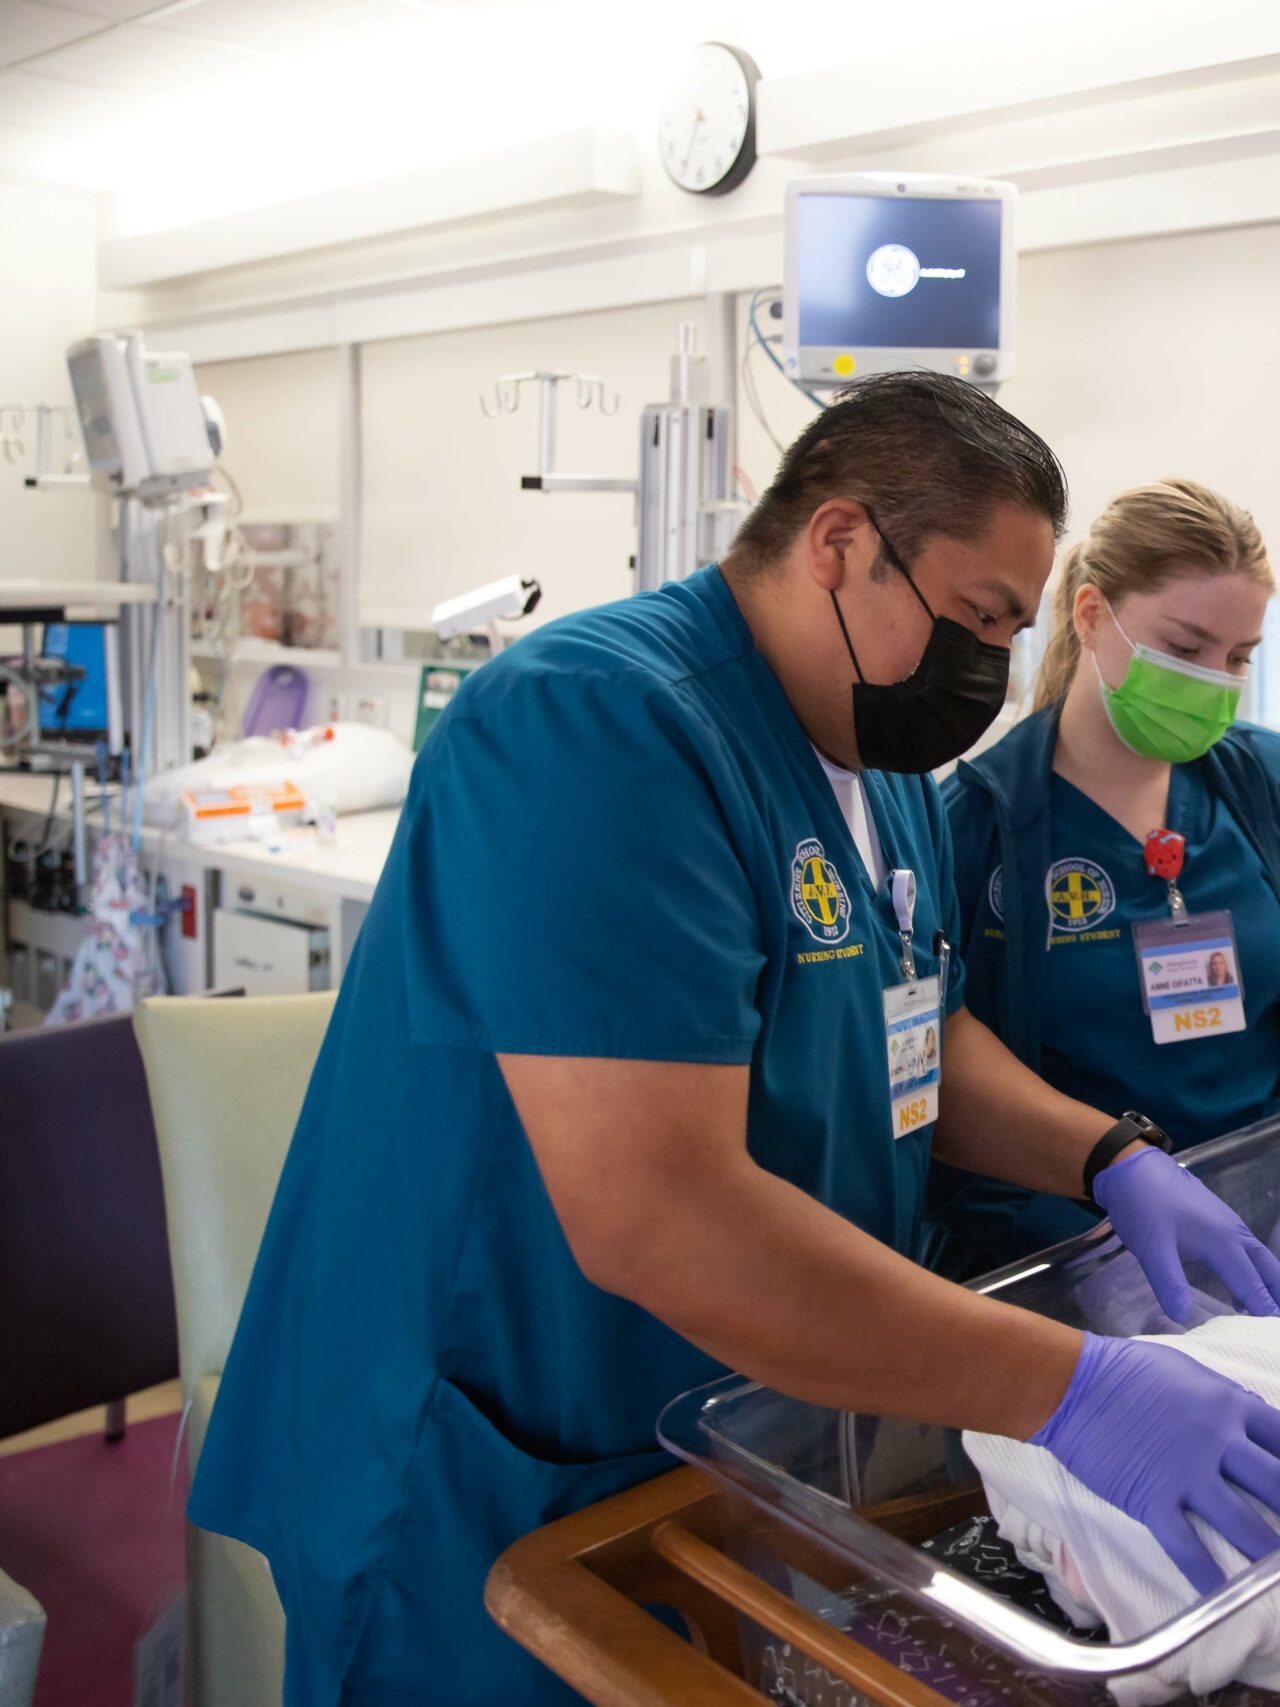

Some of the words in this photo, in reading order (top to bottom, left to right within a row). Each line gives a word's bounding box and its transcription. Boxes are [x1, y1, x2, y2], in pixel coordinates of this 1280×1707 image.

[1080, 928, 1121, 942] STUDENT
[796, 949, 836, 965] NURSING
[1150, 982, 1171, 992] ANNE
[1173, 1007, 1223, 1033] NS2
[900, 1098, 928, 1131] NS2
